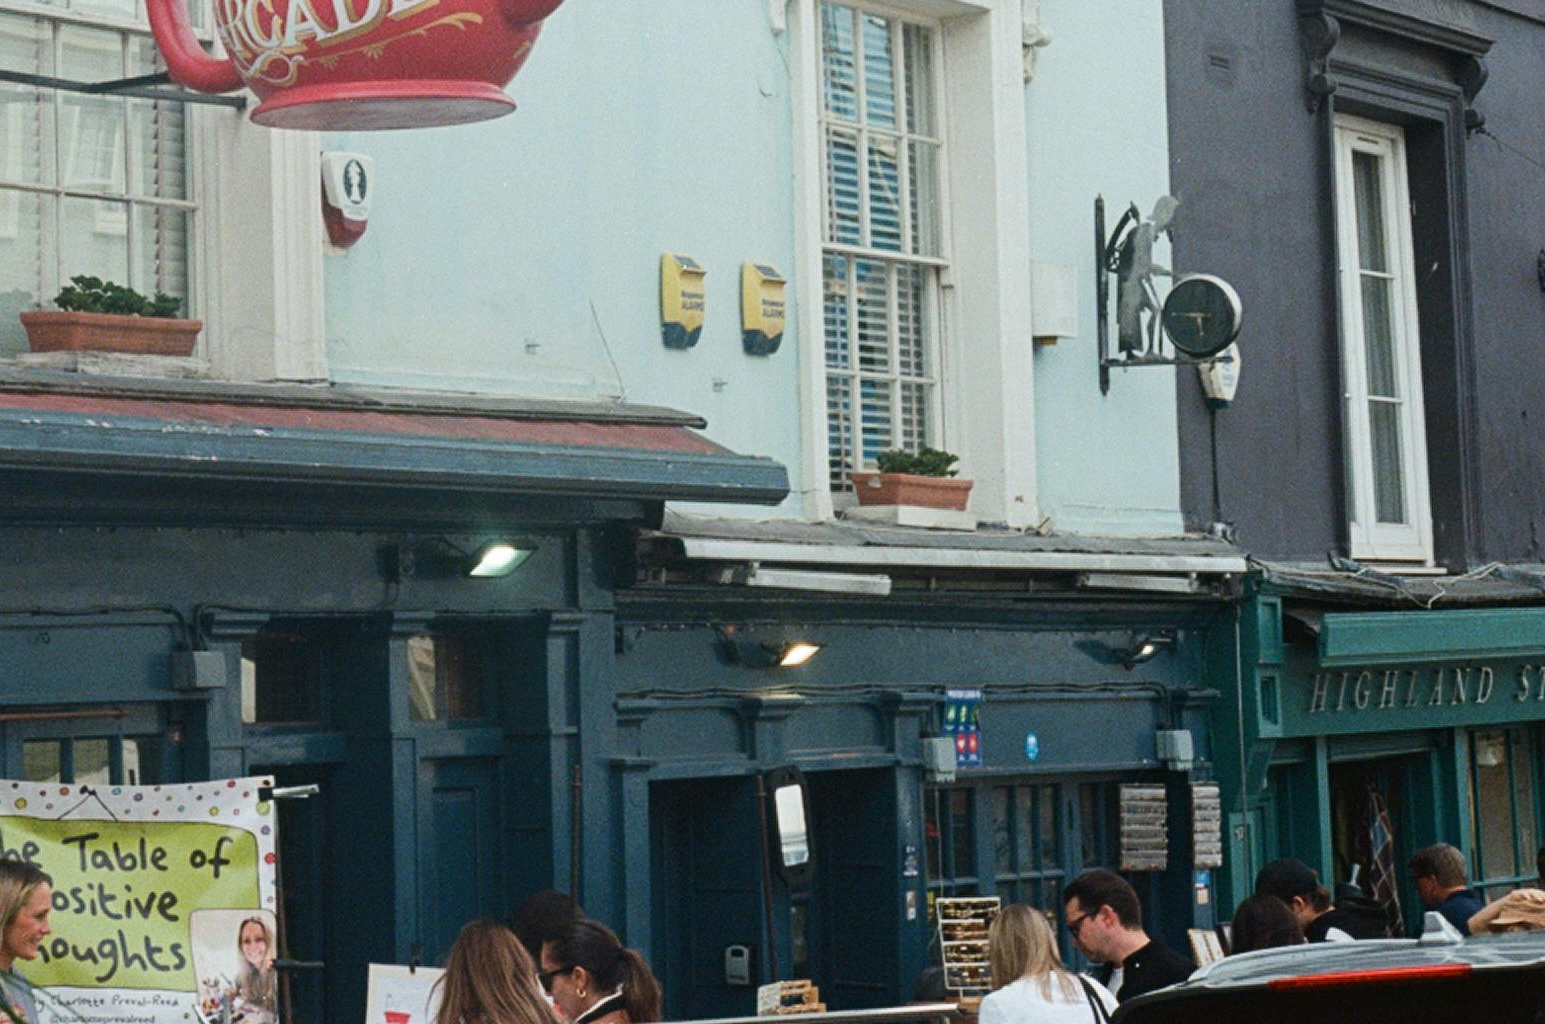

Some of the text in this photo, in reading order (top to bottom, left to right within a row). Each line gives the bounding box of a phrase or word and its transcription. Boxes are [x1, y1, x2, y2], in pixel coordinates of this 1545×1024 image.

[1308, 666, 1495, 714] HIGHLAND
[61, 831, 169, 873] Table
[190, 835, 234, 879] of
[52, 881, 179, 922] ositive
[36, 928, 187, 983] oughts
